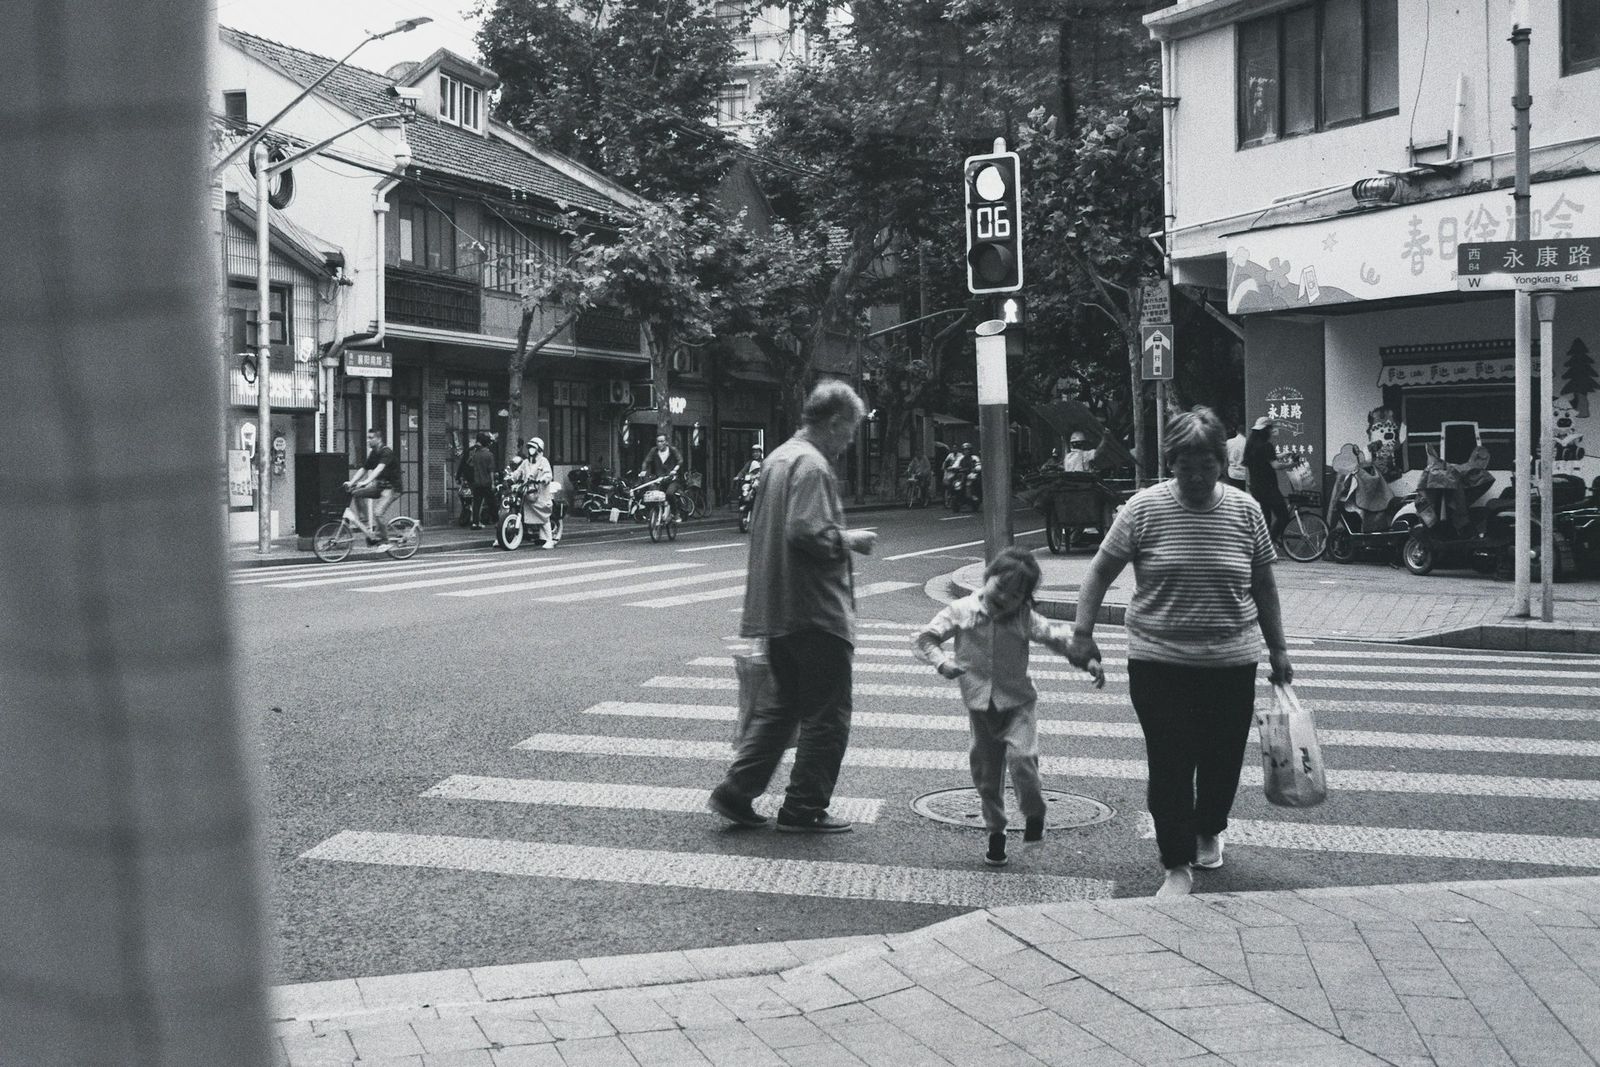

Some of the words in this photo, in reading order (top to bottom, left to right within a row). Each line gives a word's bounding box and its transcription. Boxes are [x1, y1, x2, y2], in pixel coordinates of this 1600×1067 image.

[977, 206, 1010, 238] 06
[1468, 248, 1480, 260] 西
[1503, 244, 1592, 269] 永康路
[1468, 278, 1481, 288] W
[1513, 274, 1560, 285] Yongkang
[1564, 273, 1579, 283] Rd
[1268, 403, 1302, 419] 永康路
